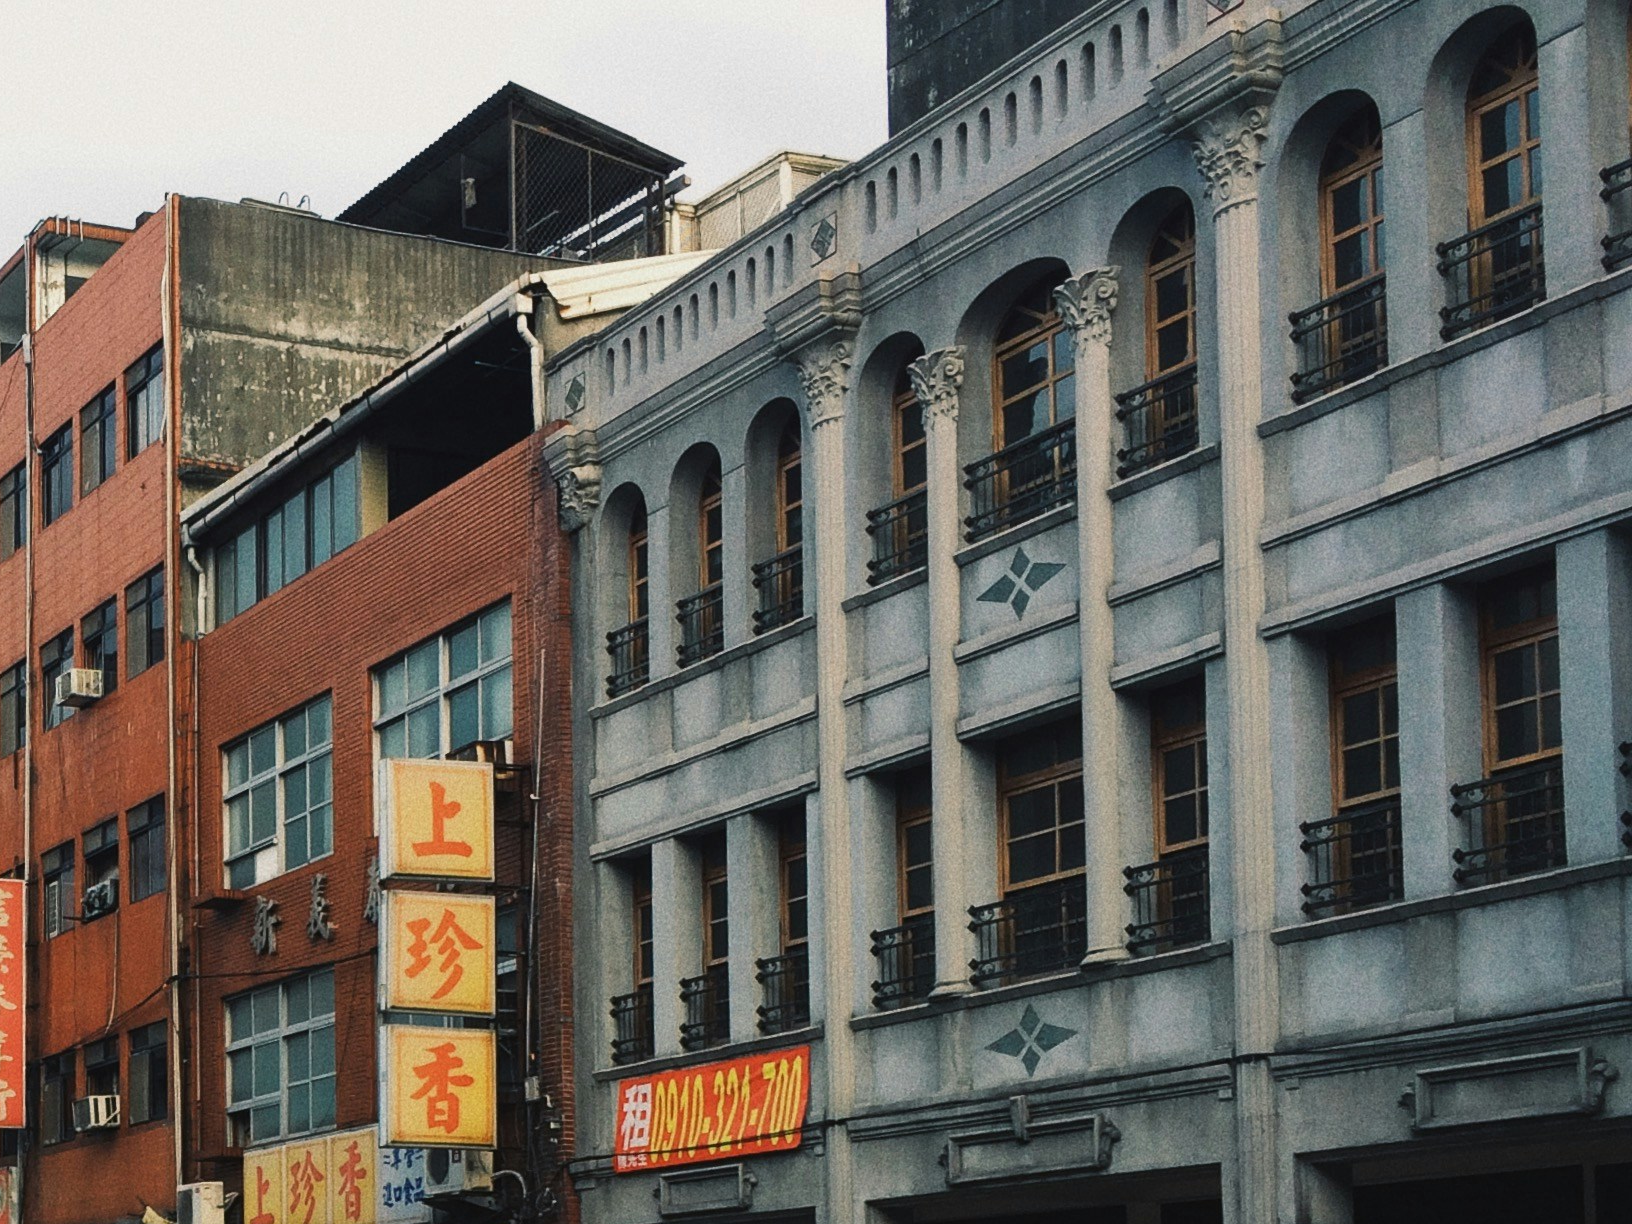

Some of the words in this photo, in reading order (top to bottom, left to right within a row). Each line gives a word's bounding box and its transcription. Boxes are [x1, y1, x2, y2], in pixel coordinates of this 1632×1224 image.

[405, 782, 483, 1135] 上珍香
[621, 1083, 652, 1150] 租
[650, 1055, 802, 1163] 0910-321-700
